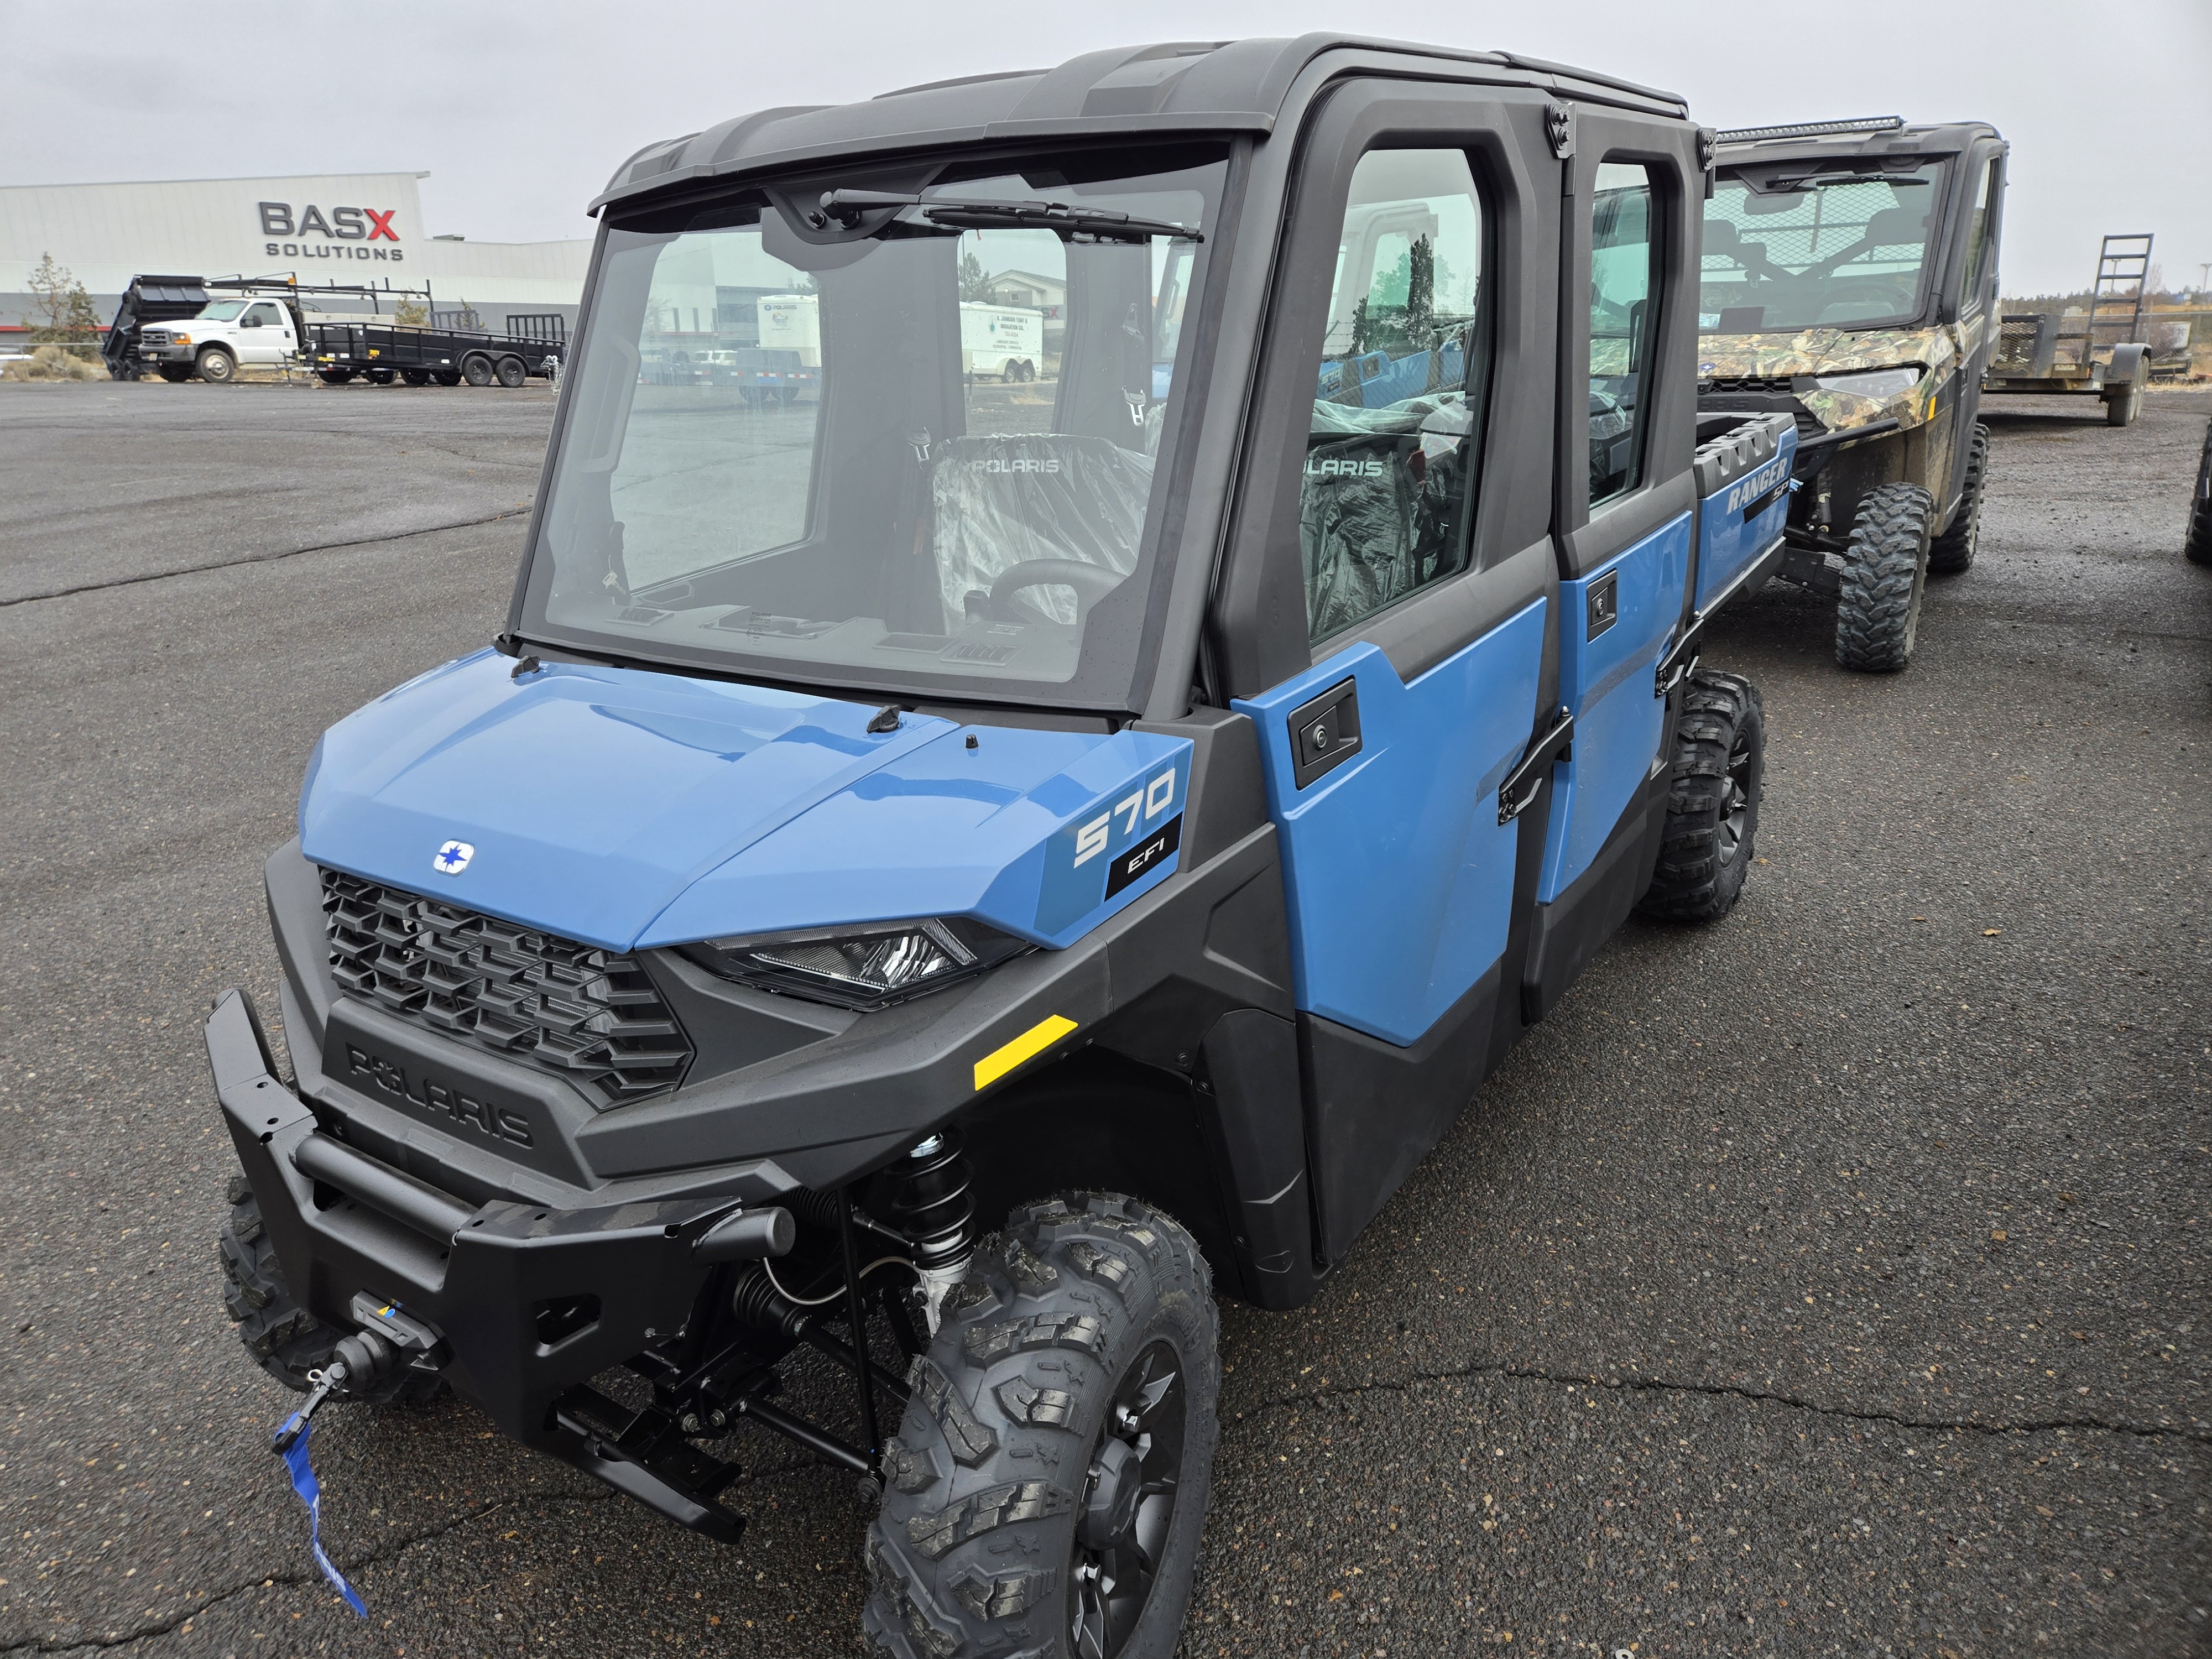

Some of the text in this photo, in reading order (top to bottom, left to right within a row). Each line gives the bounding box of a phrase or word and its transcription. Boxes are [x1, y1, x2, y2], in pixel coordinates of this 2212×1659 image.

[259, 201, 400, 241] BASX
[266, 243, 403, 261] SOLUTIONS
[1321, 369, 1340, 384] 570
[972, 459, 1059, 473] POLARIS
[1302, 460, 1383, 476] LARIS
[1726, 457, 1788, 515] RANGER
[1772, 480, 1790, 501] SP
[1073, 767, 1176, 869] 570
[1127, 837, 1165, 874] EFI
[345, 1042, 534, 1149] POLARIS
